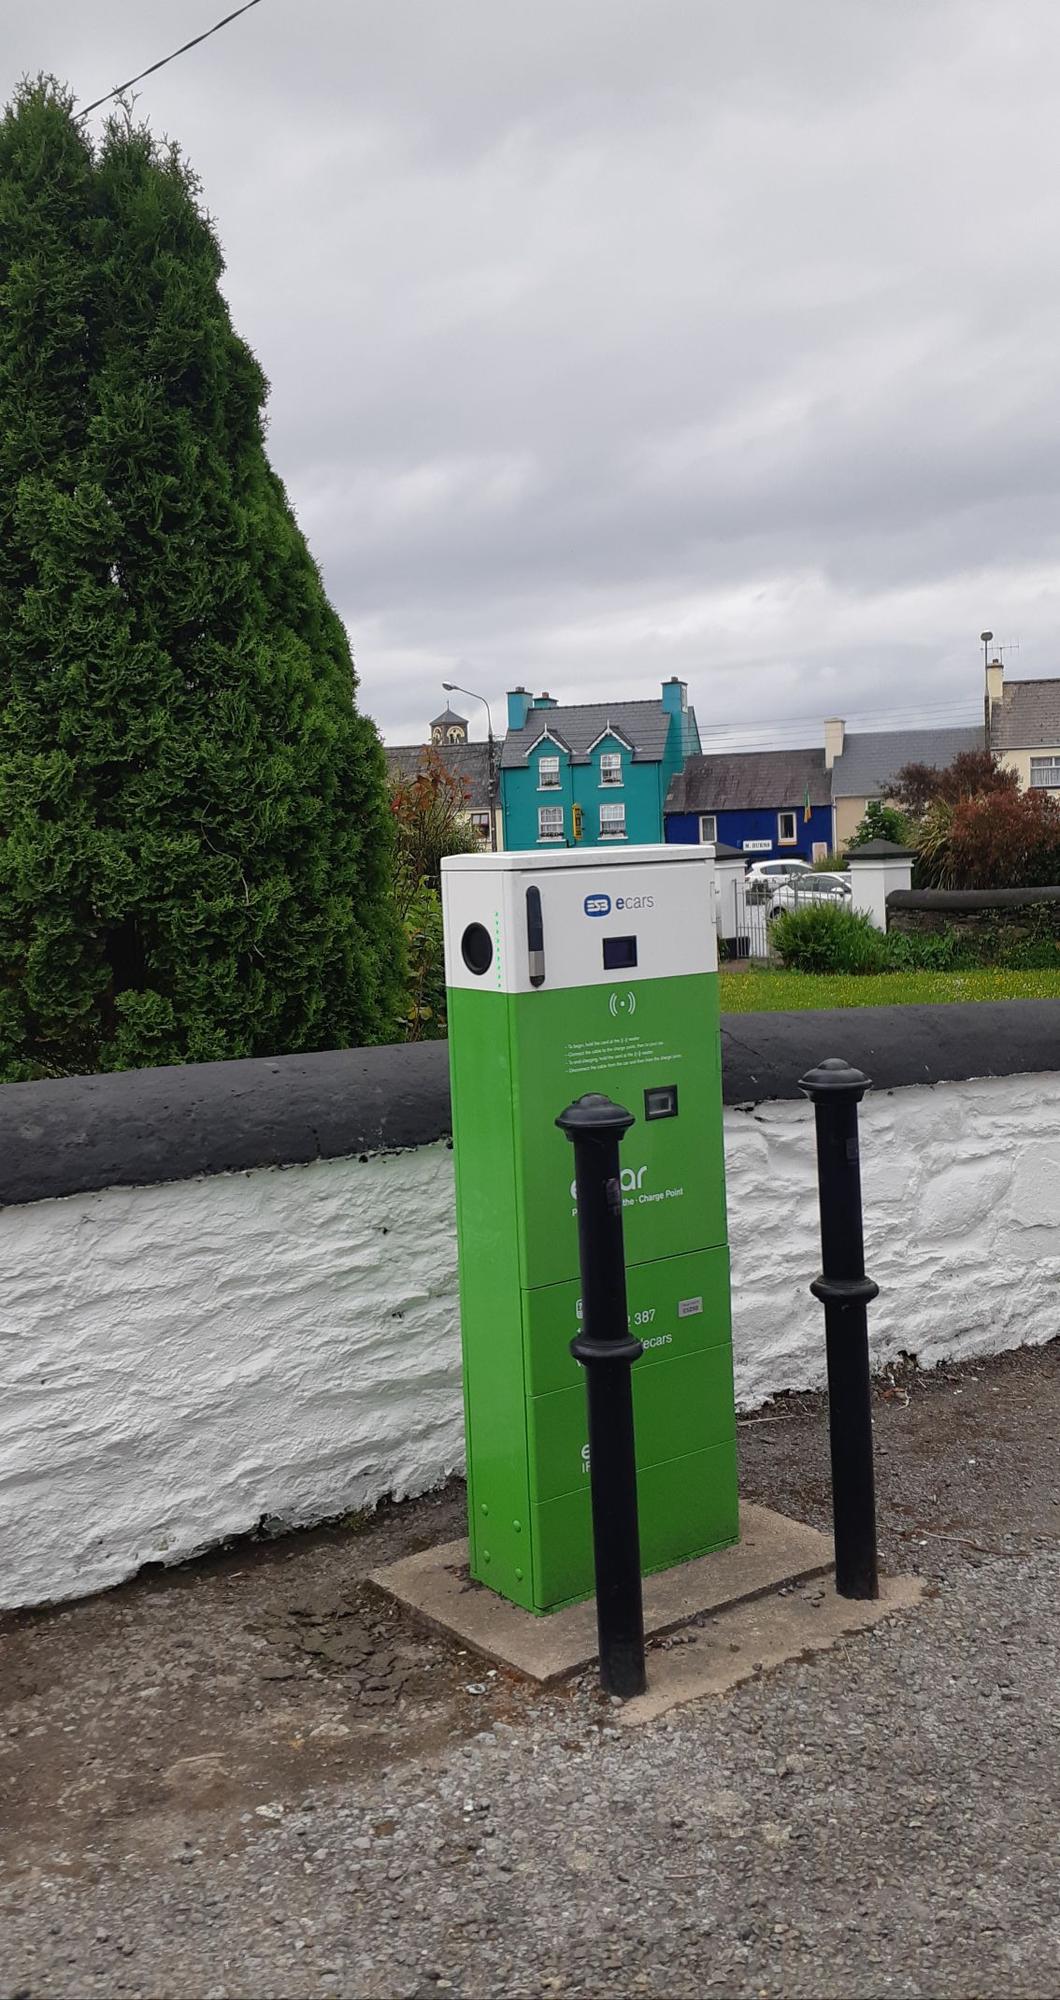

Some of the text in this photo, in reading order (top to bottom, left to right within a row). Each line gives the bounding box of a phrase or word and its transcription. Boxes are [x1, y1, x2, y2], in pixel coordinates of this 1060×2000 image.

[616, 896, 654, 910] ecars
[638, 1191, 664, 1204] Charge
[665, 1187, 684, 1197] Point
[634, 1309, 656, 1325] 387
